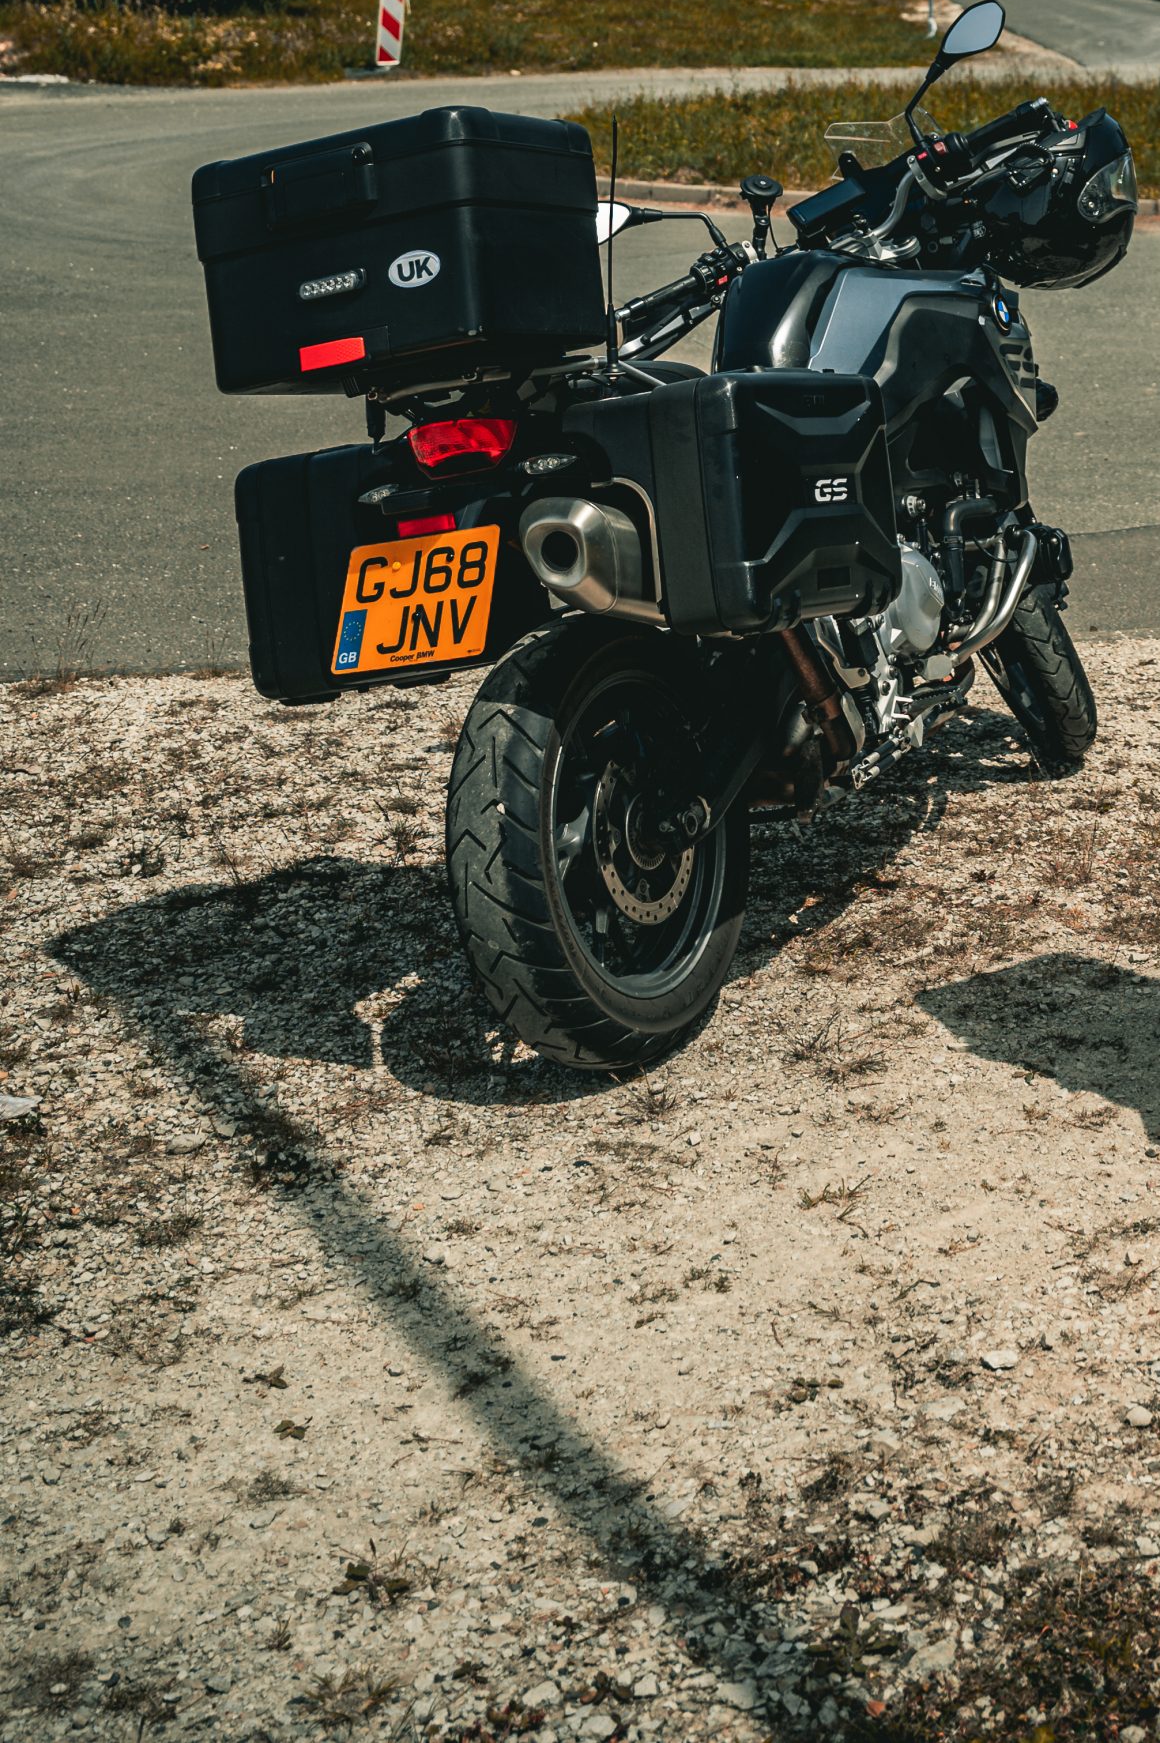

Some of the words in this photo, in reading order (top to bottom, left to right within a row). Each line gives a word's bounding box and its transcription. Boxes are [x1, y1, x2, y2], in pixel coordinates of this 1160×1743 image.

[396, 256, 434, 282] UK
[814, 478, 848, 502] GS
[356, 540, 489, 604] GJ68
[376, 595, 478, 654] JNV
[338, 651, 357, 664] GB
[390, 655, 415, 663] Cooper
[415, 650, 435, 660] BMW
